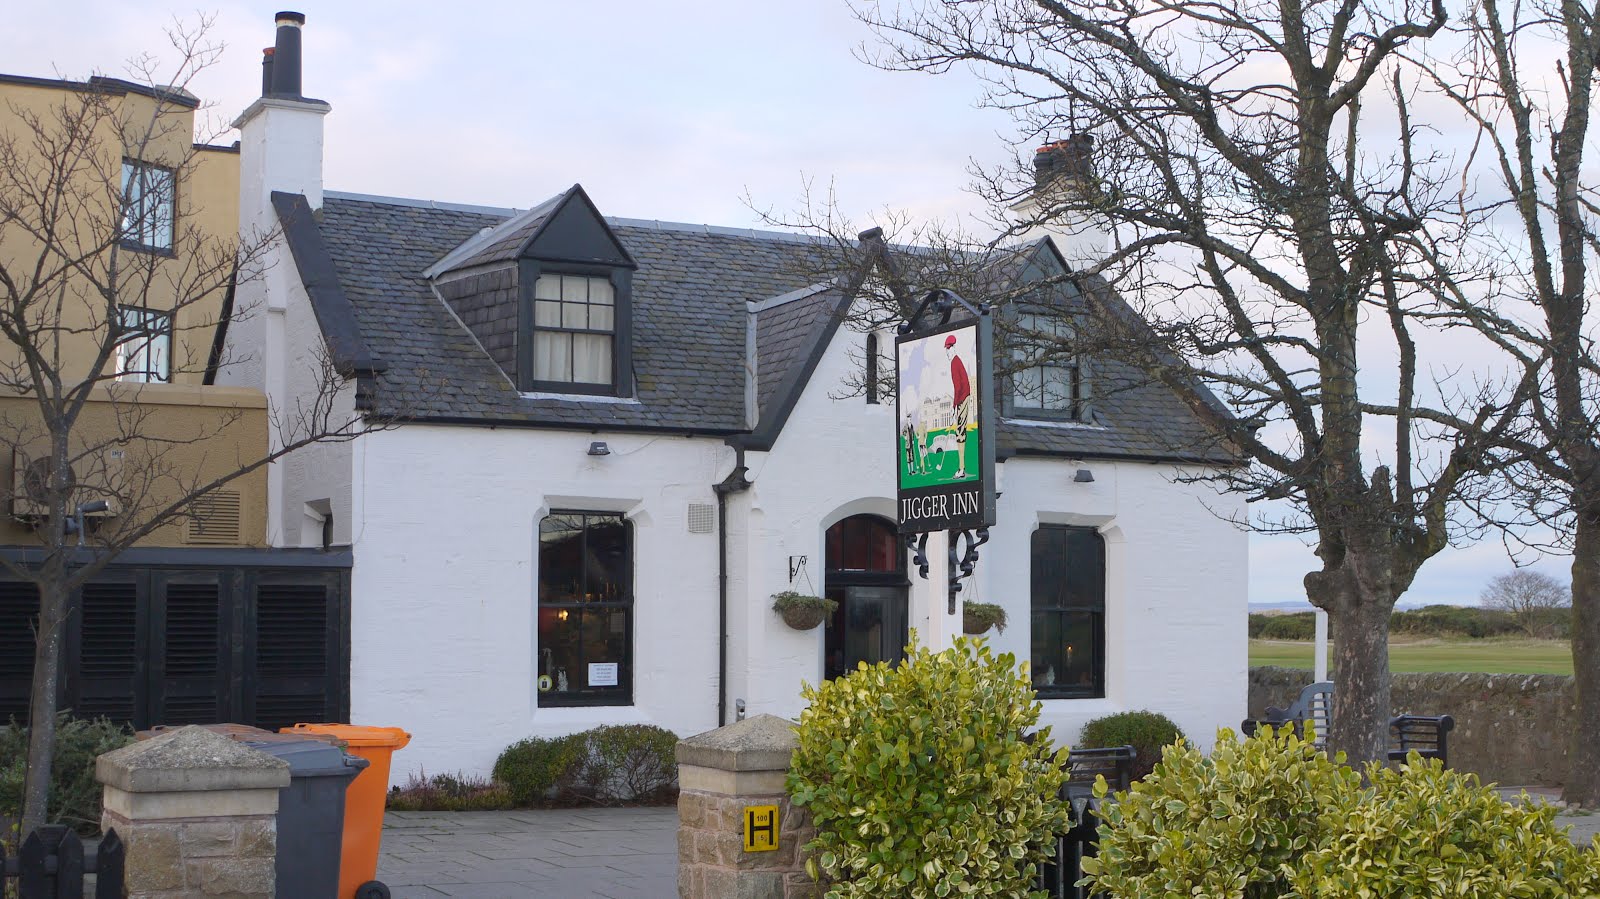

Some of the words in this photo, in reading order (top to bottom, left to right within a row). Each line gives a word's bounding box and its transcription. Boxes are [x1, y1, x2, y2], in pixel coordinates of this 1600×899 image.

[901, 494, 950, 524] JIGGER
[952, 491, 979, 515] INN
[750, 811, 773, 846] H
